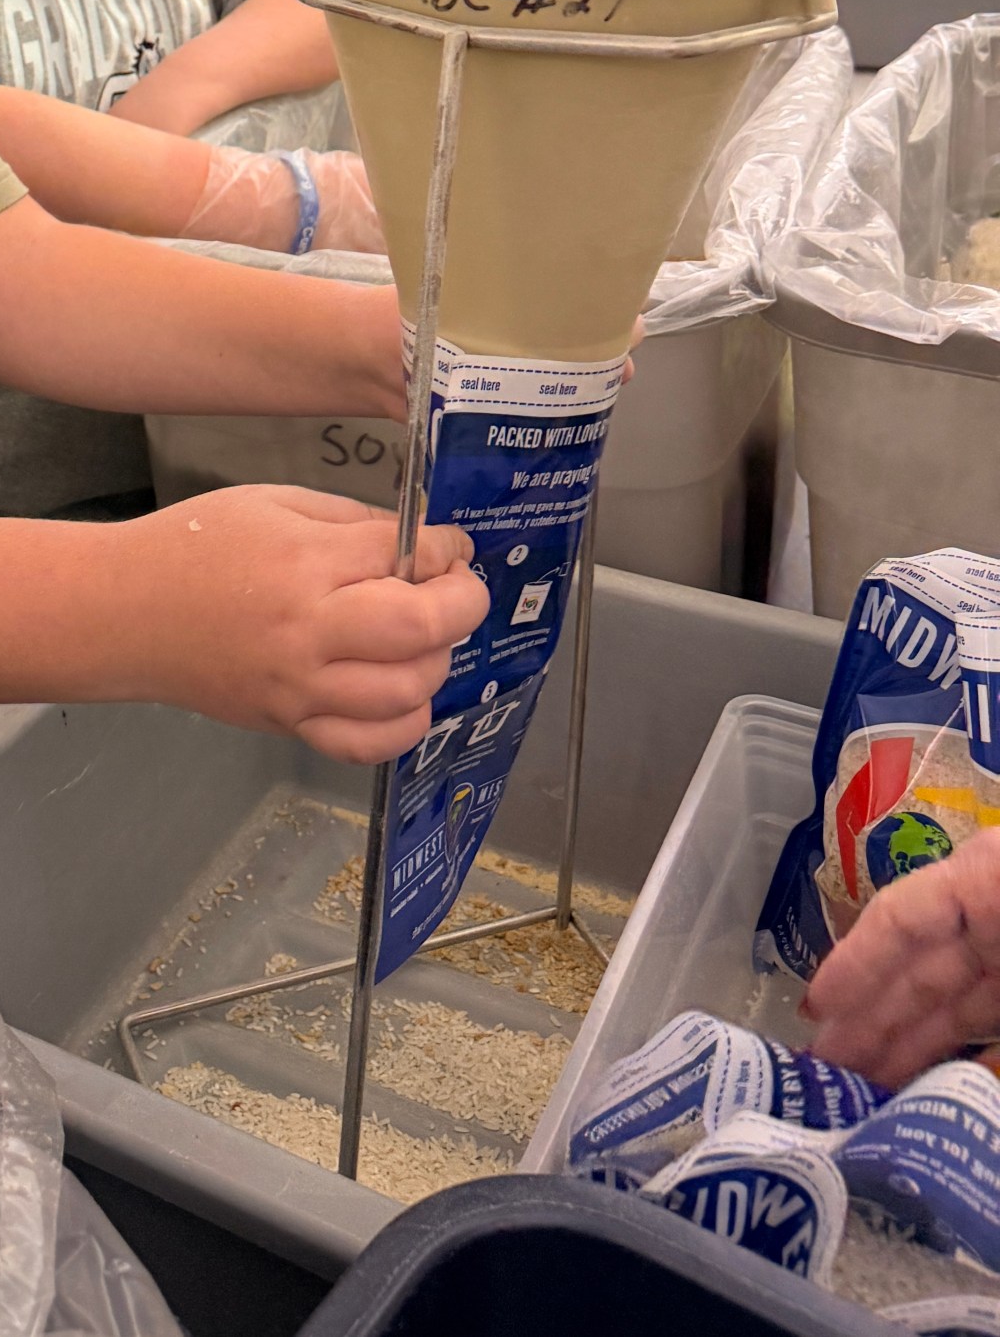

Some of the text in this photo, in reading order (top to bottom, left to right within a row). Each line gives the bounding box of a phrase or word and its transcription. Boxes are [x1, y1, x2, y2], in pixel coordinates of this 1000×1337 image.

[460, 377, 500, 391] seal here
[539, 382, 578, 395] seal here
[487, 425, 542, 448] PACKED
[544, 426, 575, 448] WITH
[574, 422, 601, 444] LOVE
[511, 471, 530, 490] We
[529, 472, 551, 487] are
[550, 464, 592, 489] praying
[889, 565, 926, 583] seal here
[957, 601, 976, 612] seal
[393, 830, 444, 891] MIDWEST
